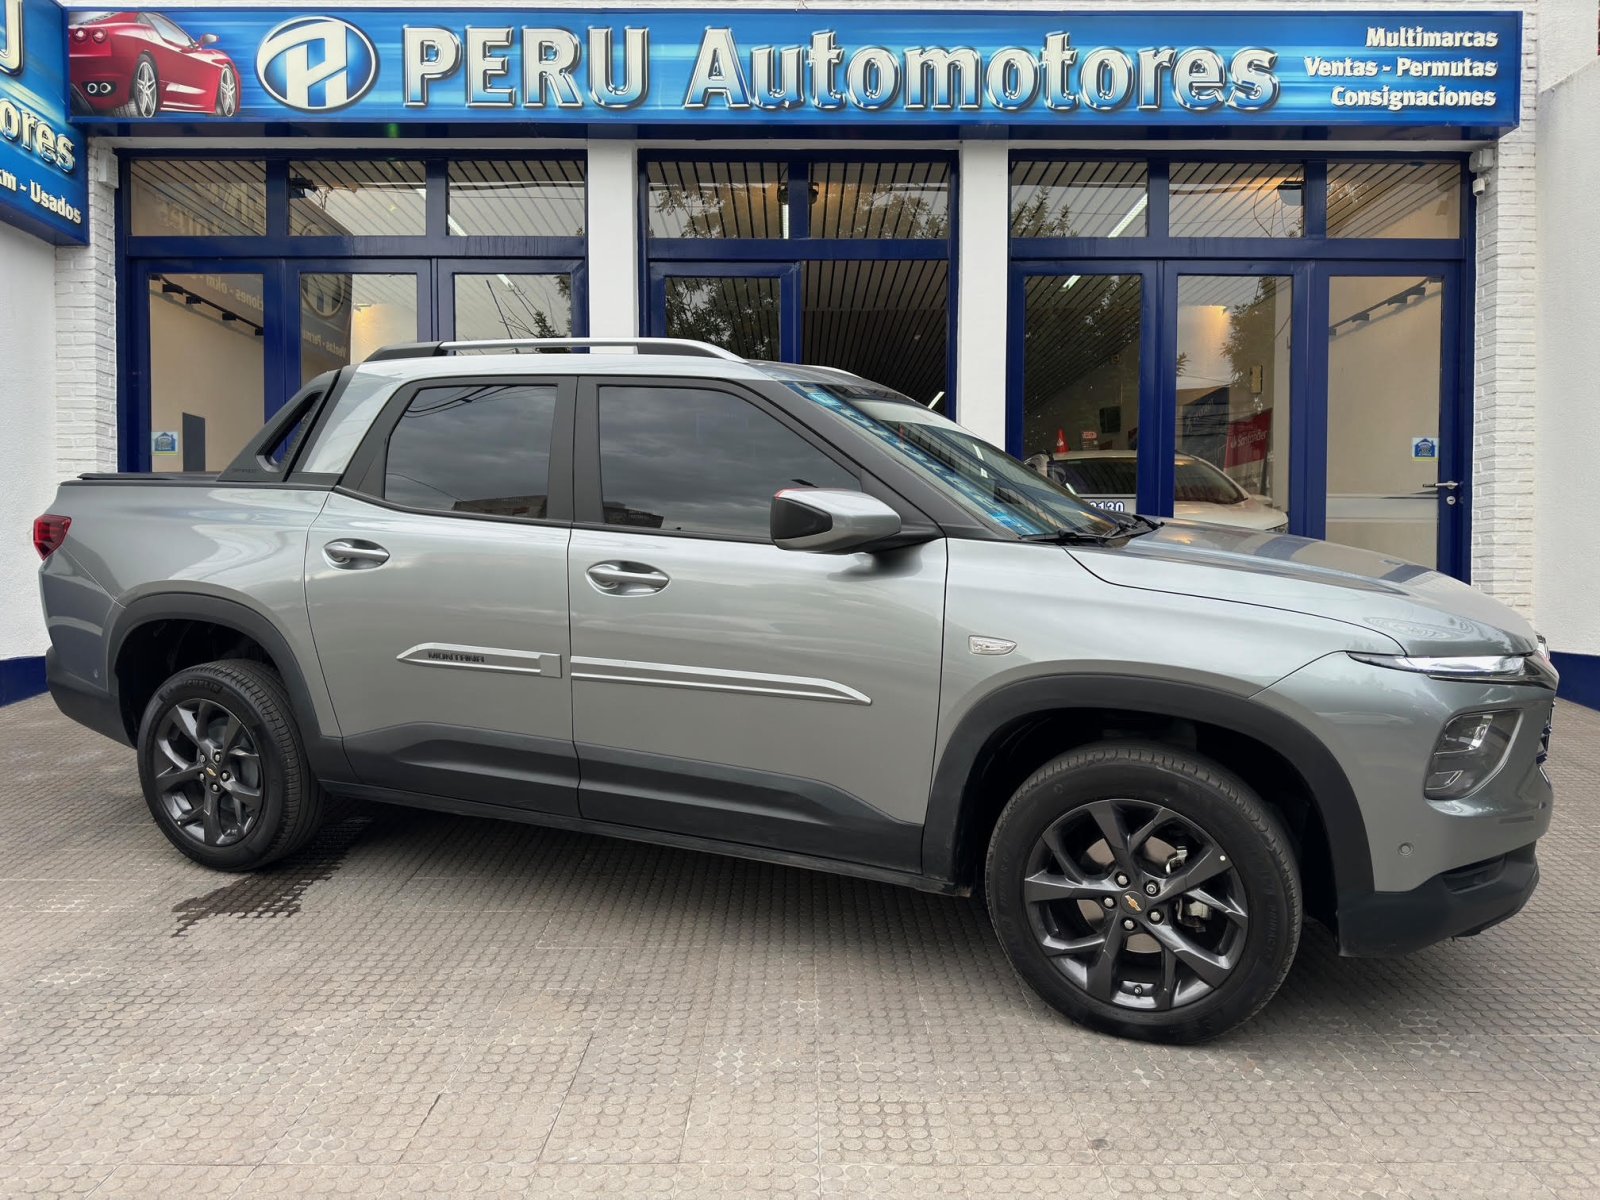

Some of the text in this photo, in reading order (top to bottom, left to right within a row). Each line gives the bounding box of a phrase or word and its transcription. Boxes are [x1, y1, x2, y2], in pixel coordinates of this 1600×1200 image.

[1365, 26, 1499, 48] Multimarcas
[403, 24, 649, 109] PERU
[683, 25, 1281, 112] Automotores
[1304, 56, 1378, 77] Ventas
[1396, 57, 1498, 77] Permutas
[1331, 85, 1497, 111] Consignaciones
[30, 178, 81, 224] Usados
